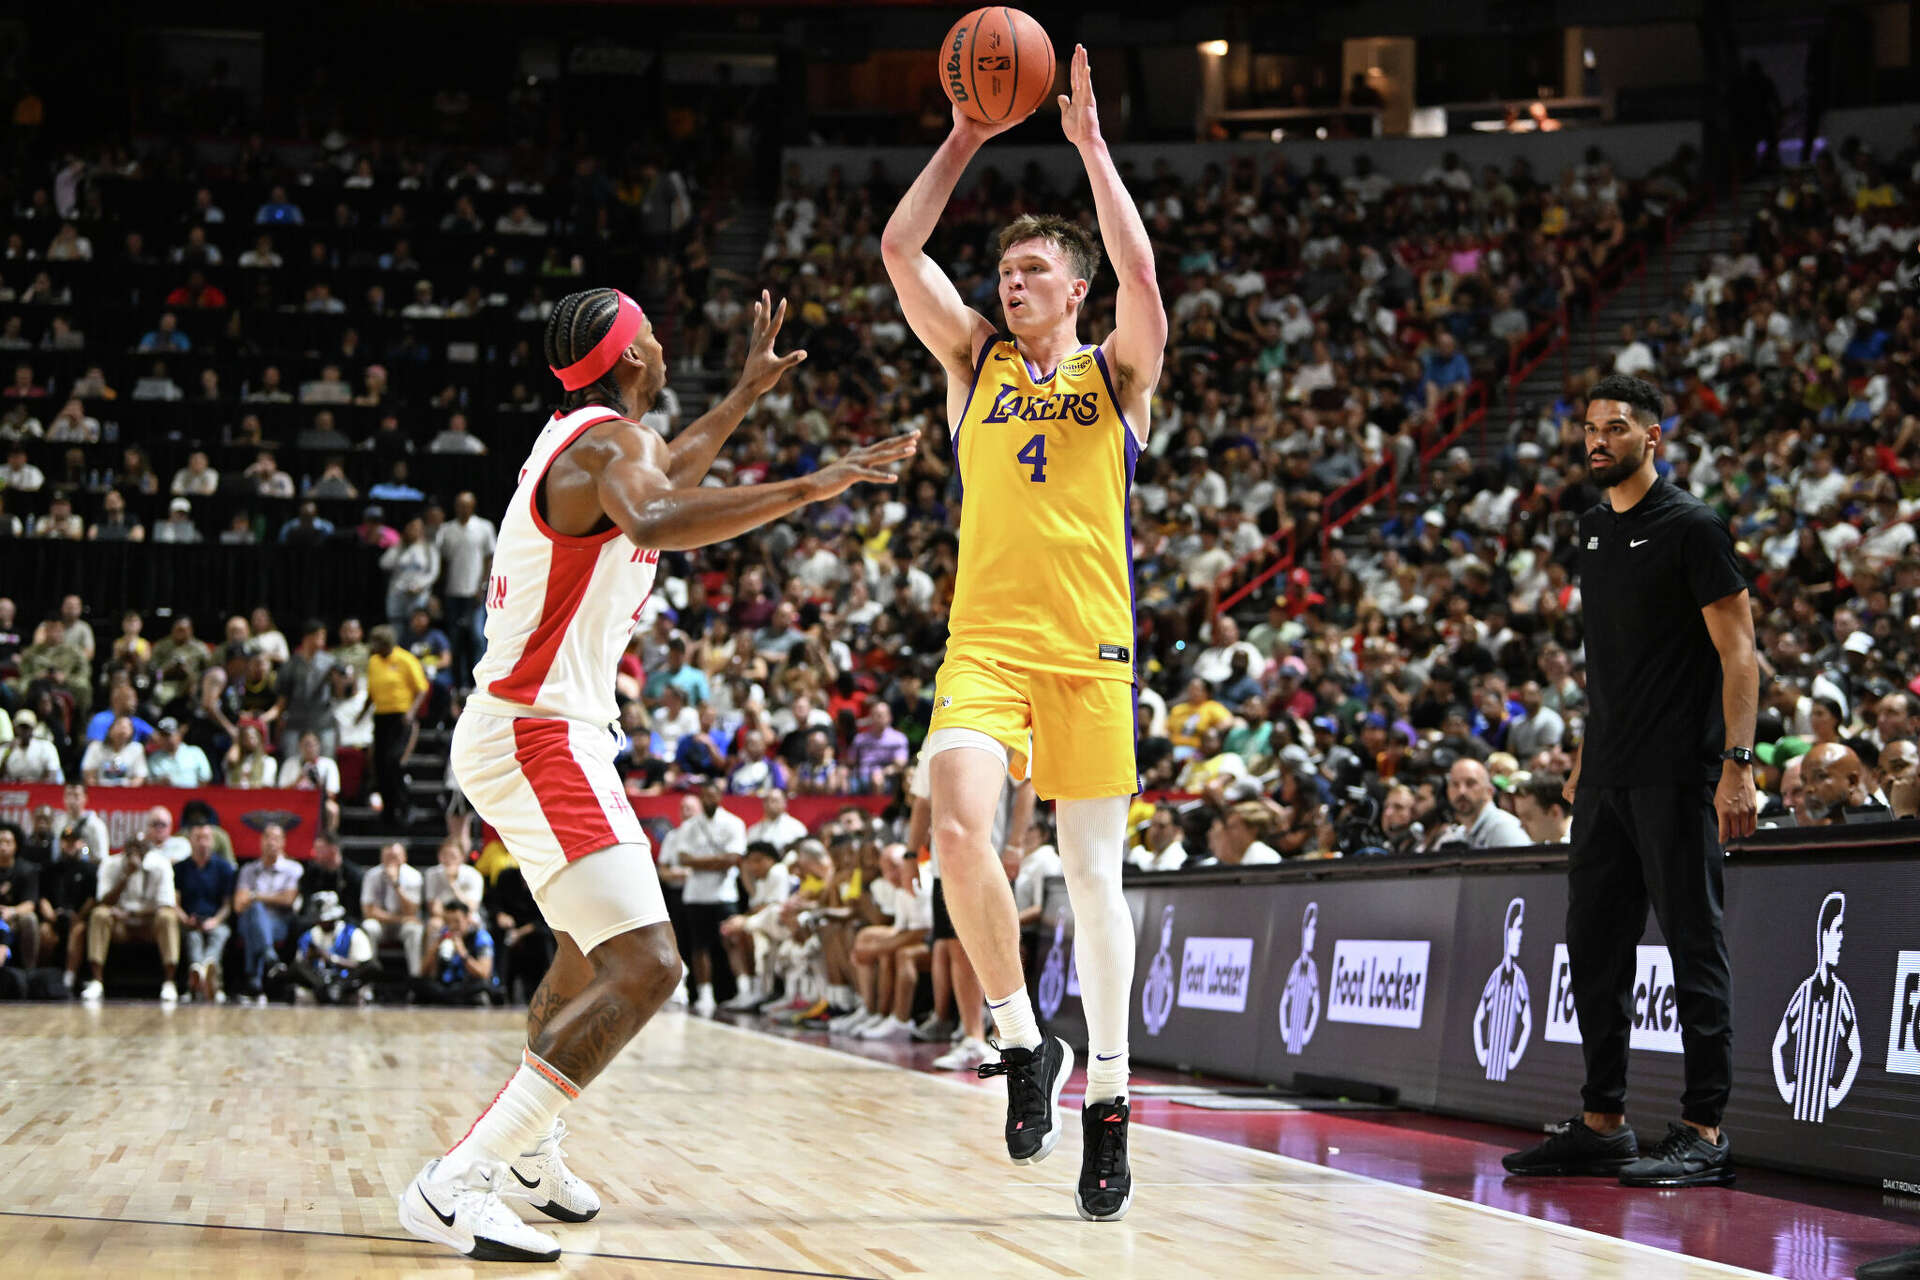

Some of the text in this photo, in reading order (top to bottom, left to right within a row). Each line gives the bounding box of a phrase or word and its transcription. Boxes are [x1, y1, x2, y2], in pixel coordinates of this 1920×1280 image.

[947, 27, 968, 102] Wilson
[982, 384, 1100, 426] LAKERS
[1016, 434, 1047, 482] 4
[1333, 955, 1422, 1011] Foot Locker
